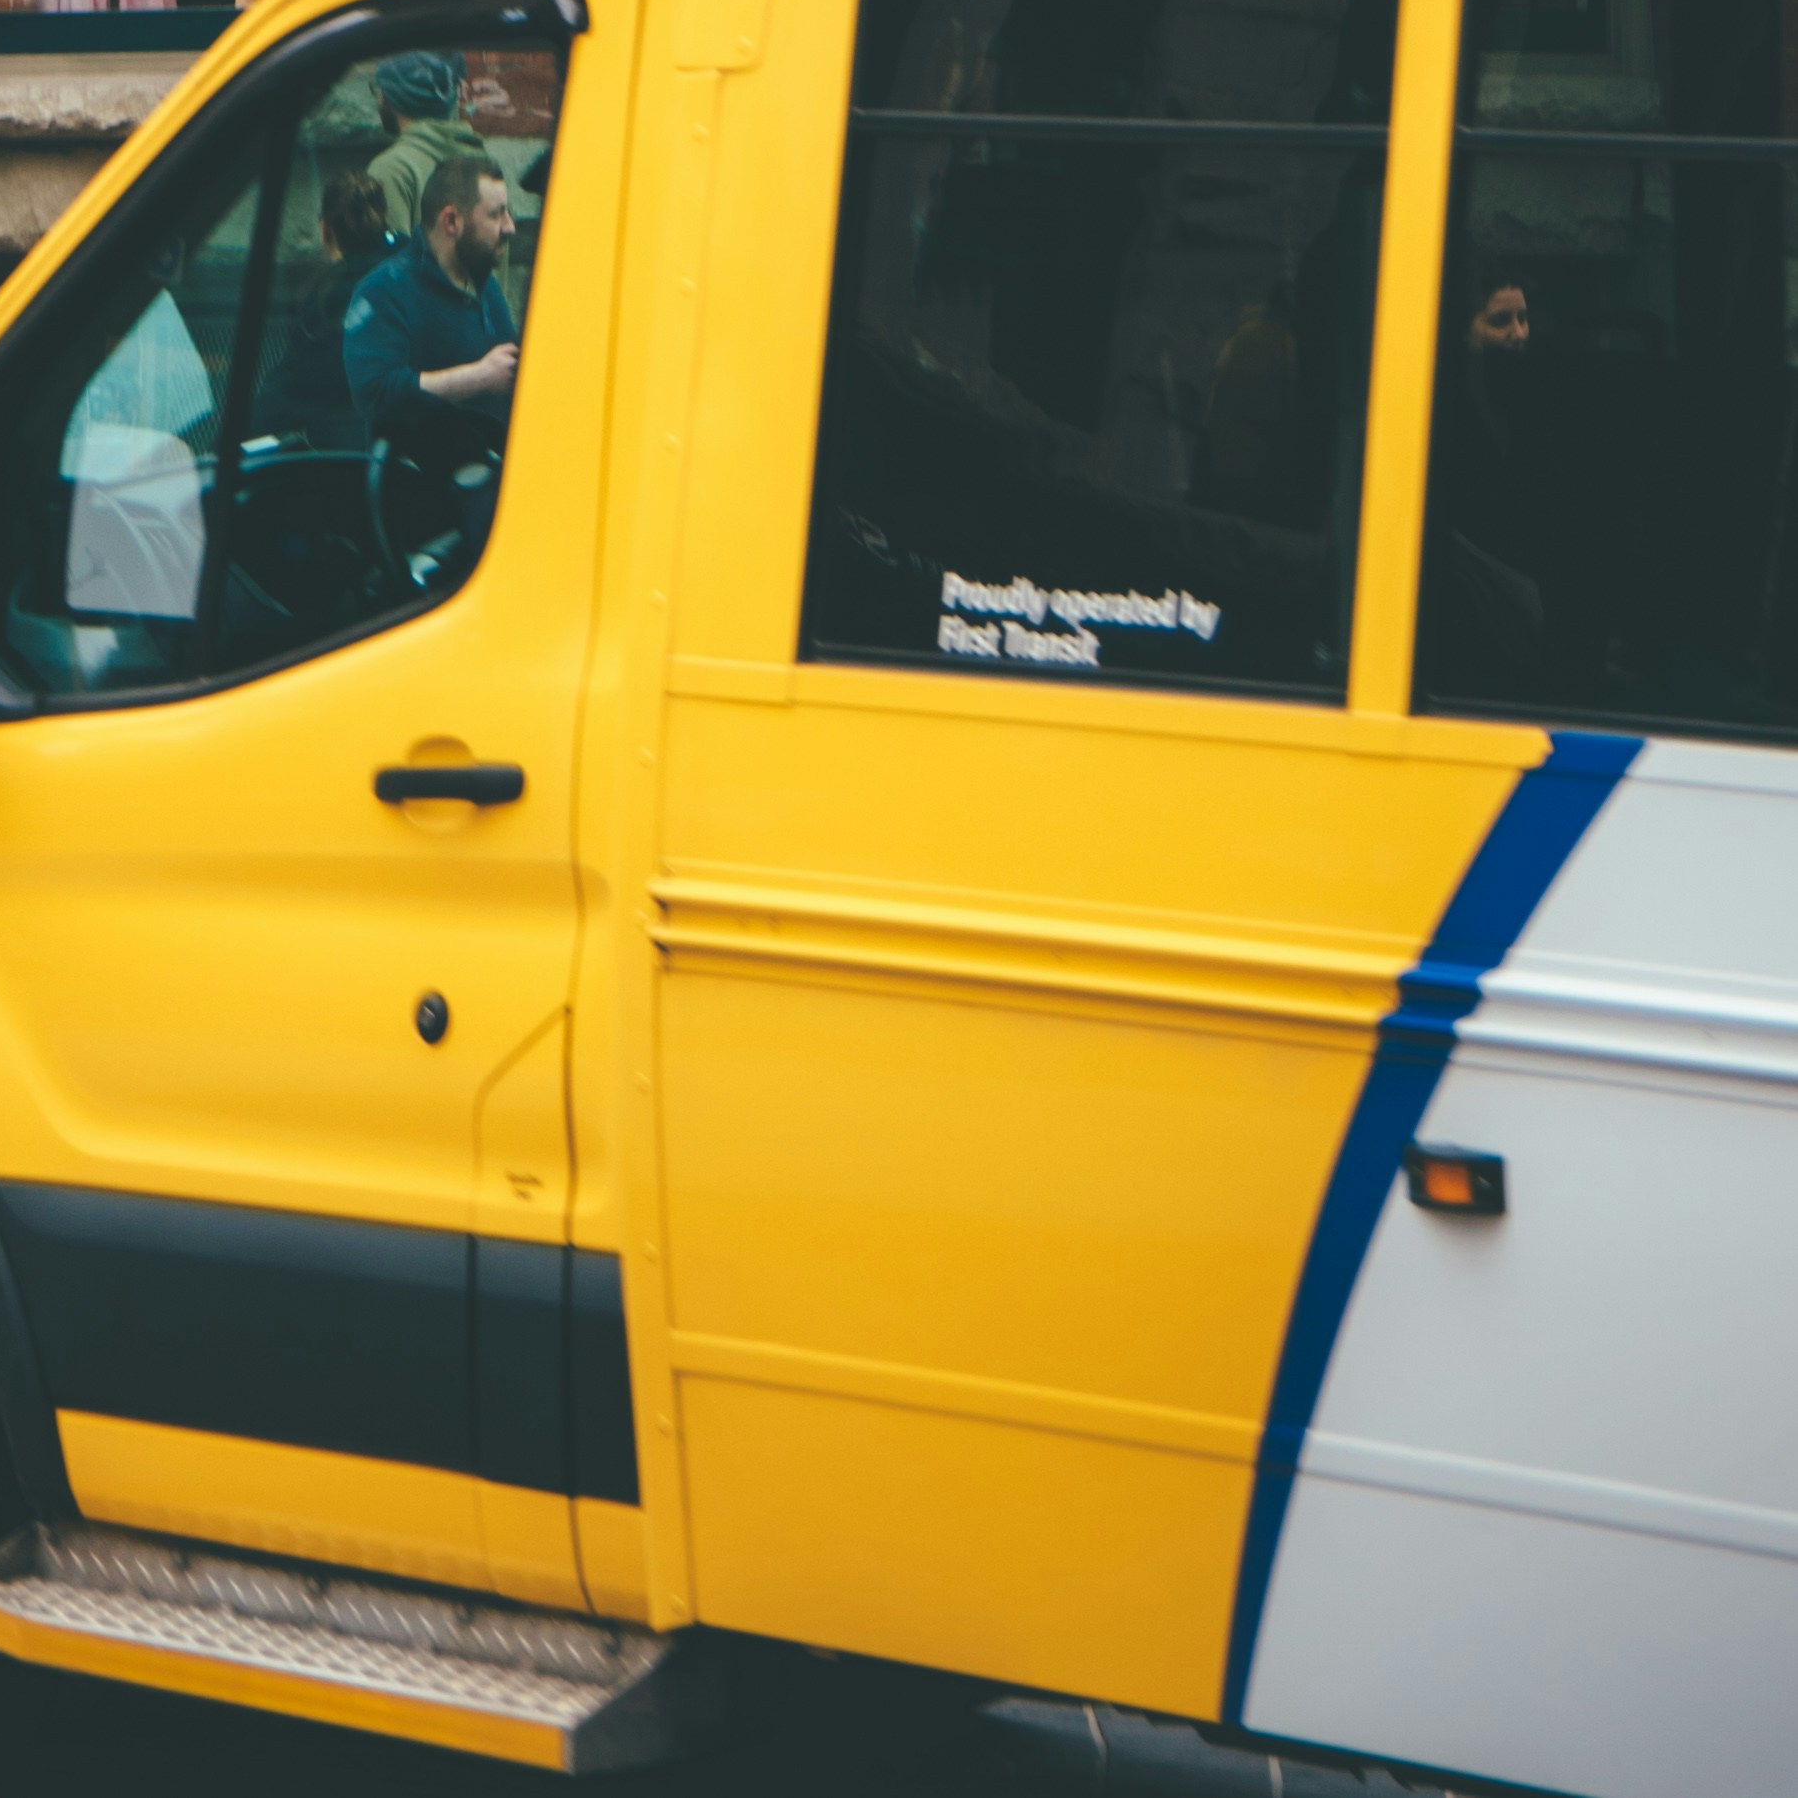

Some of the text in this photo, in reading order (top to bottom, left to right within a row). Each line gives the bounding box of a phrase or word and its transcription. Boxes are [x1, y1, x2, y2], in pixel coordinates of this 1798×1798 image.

[941, 570, 1222, 642] Proudly operated by
[937, 614, 1101, 667] First Transit
